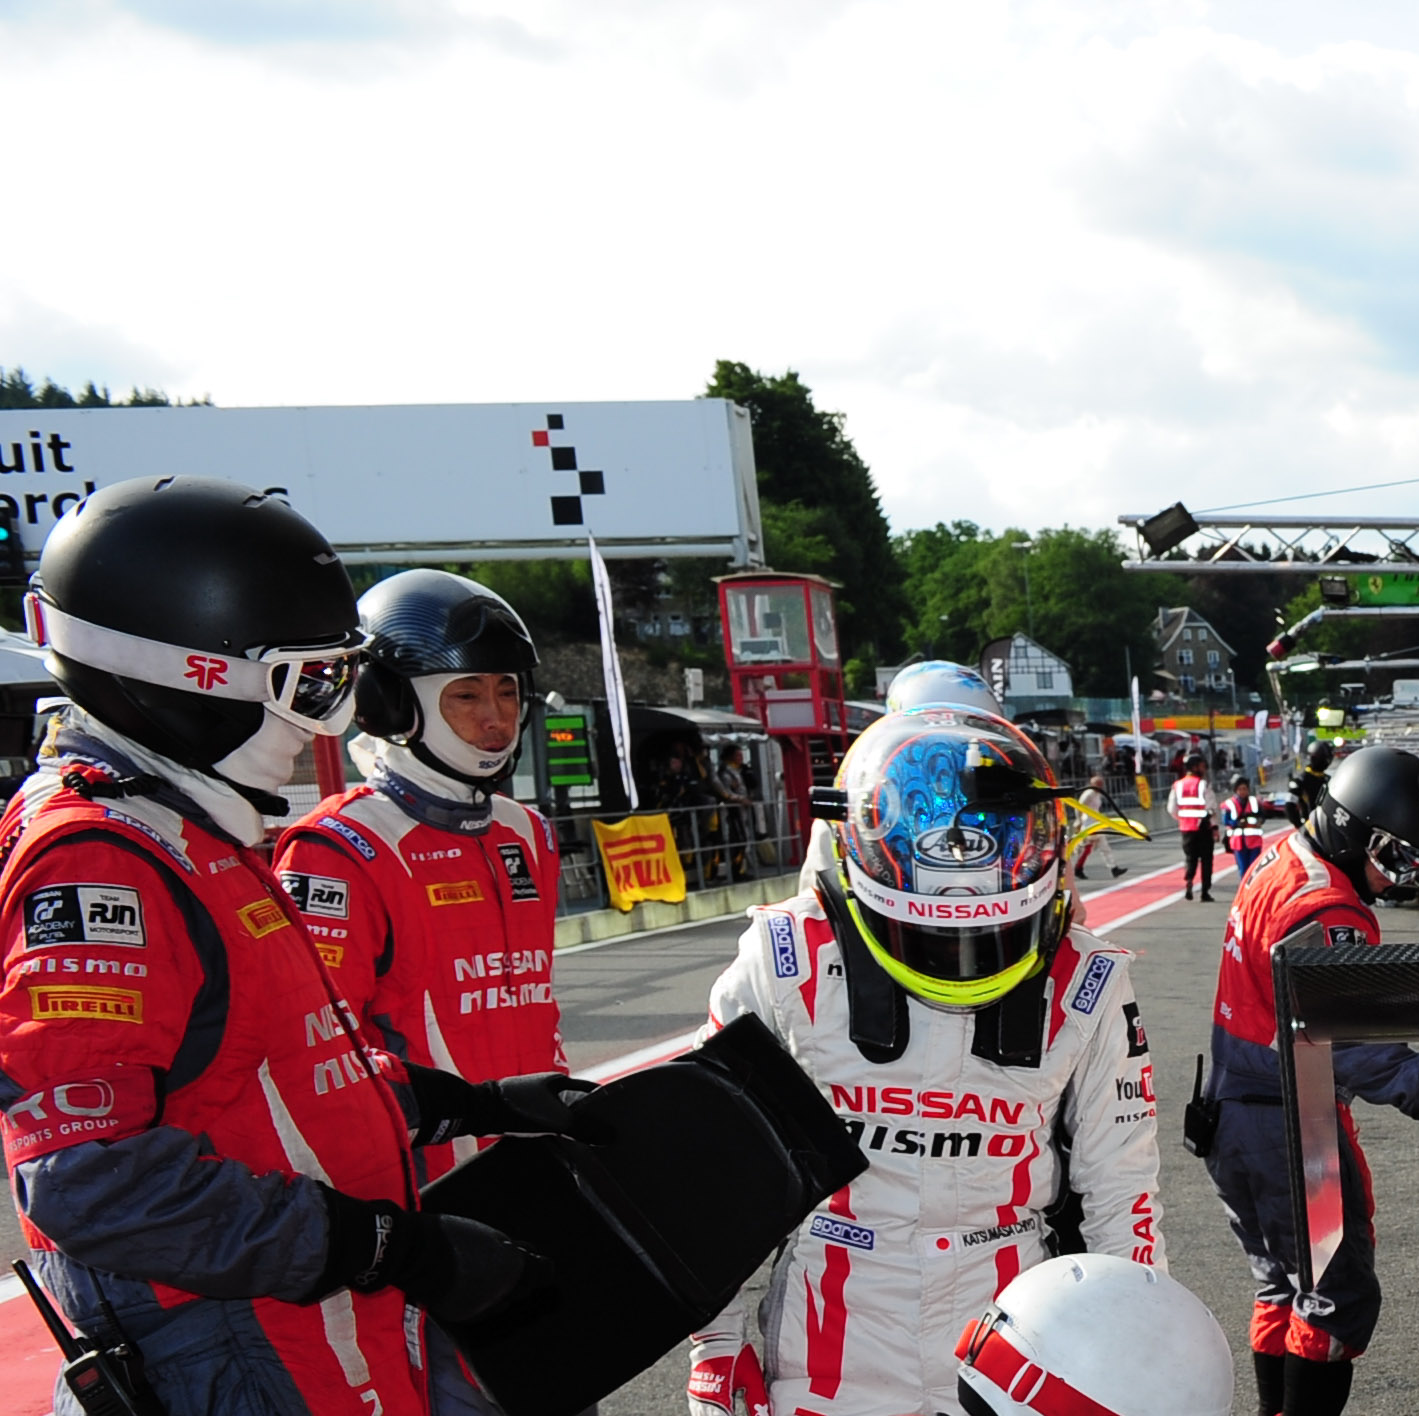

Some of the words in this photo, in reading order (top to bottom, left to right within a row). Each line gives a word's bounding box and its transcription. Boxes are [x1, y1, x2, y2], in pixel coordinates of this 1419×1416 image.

[319, 817, 377, 861] sparco
[89, 903, 136, 926] RJN
[907, 901, 1009, 919] NISSAN
[21, 958, 148, 977] nismo
[37, 992, 135, 1016] PIRELLI
[831, 1084, 1025, 1125] NISSAN
[60, 1118, 120, 1136] GROUP
[812, 1217, 873, 1246] sparco
